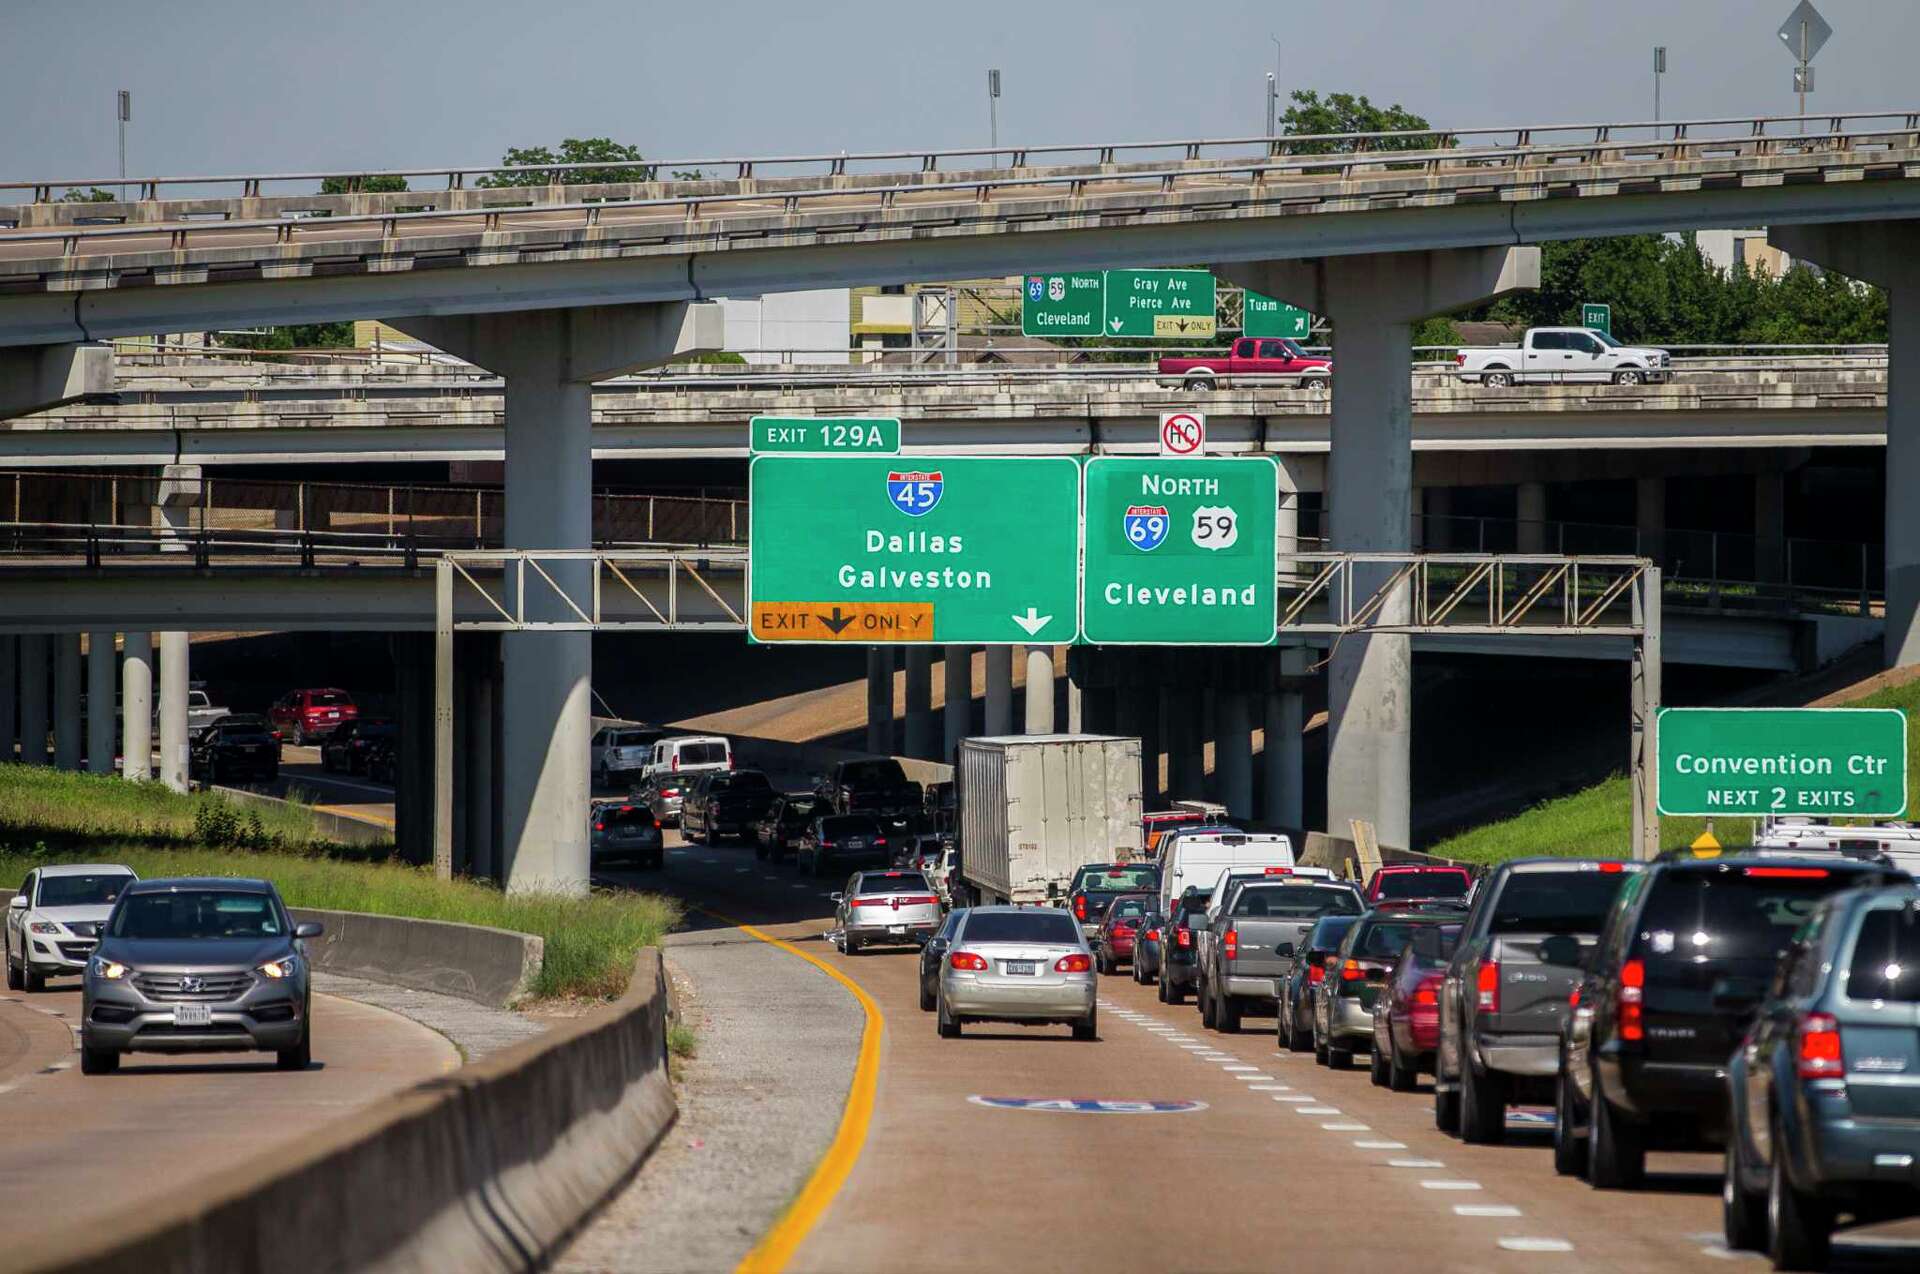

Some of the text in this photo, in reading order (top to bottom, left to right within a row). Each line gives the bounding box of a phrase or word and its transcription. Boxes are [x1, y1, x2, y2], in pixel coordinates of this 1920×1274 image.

[1030, 277, 1099, 296] 69 59 NORTH
[1134, 278, 1188, 292] Gray Ave
[1130, 297, 1191, 309] Pierce Ave
[1249, 299, 1277, 311] Tuam
[1037, 312, 1090, 325] Cleveland
[1157, 321, 1211, 330] EXIT ONLY
[1588, 312, 1605, 323] EXIT
[767, 425, 883, 447] EXIT 129A
[1170, 424, 1195, 444] HC
[896, 483, 935, 507] 45
[1142, 474, 1219, 496] NORTH
[1129, 516, 1233, 541] 69 59
[866, 530, 963, 553] Dallas
[838, 565, 991, 589] Galveston
[1104, 583, 1256, 605] Cleveland
[761, 613, 923, 629] EXIT ONLY
[1675, 753, 1887, 775] Convention Ctr
[1707, 787, 1855, 809] NEXT 2 EXITS
